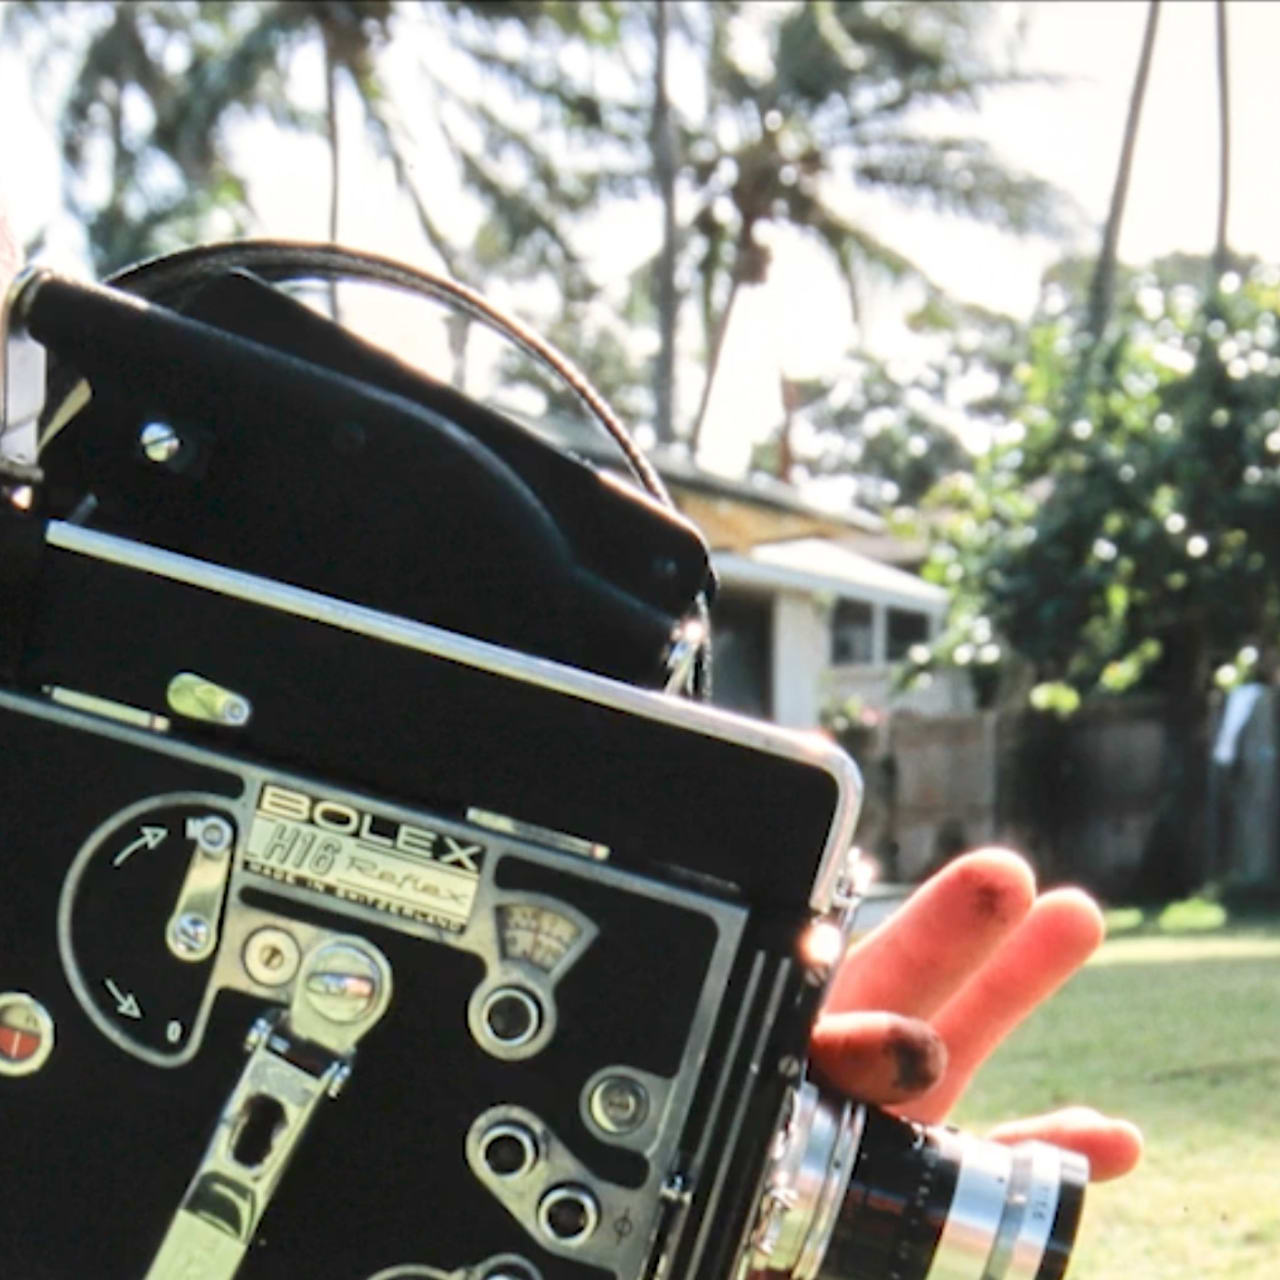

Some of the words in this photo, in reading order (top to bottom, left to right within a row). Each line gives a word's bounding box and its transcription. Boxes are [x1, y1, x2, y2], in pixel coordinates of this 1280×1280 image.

[258, 783, 481, 871] BOLEX
[263, 823, 343, 877] H16
[345, 856, 470, 904] Reflex
